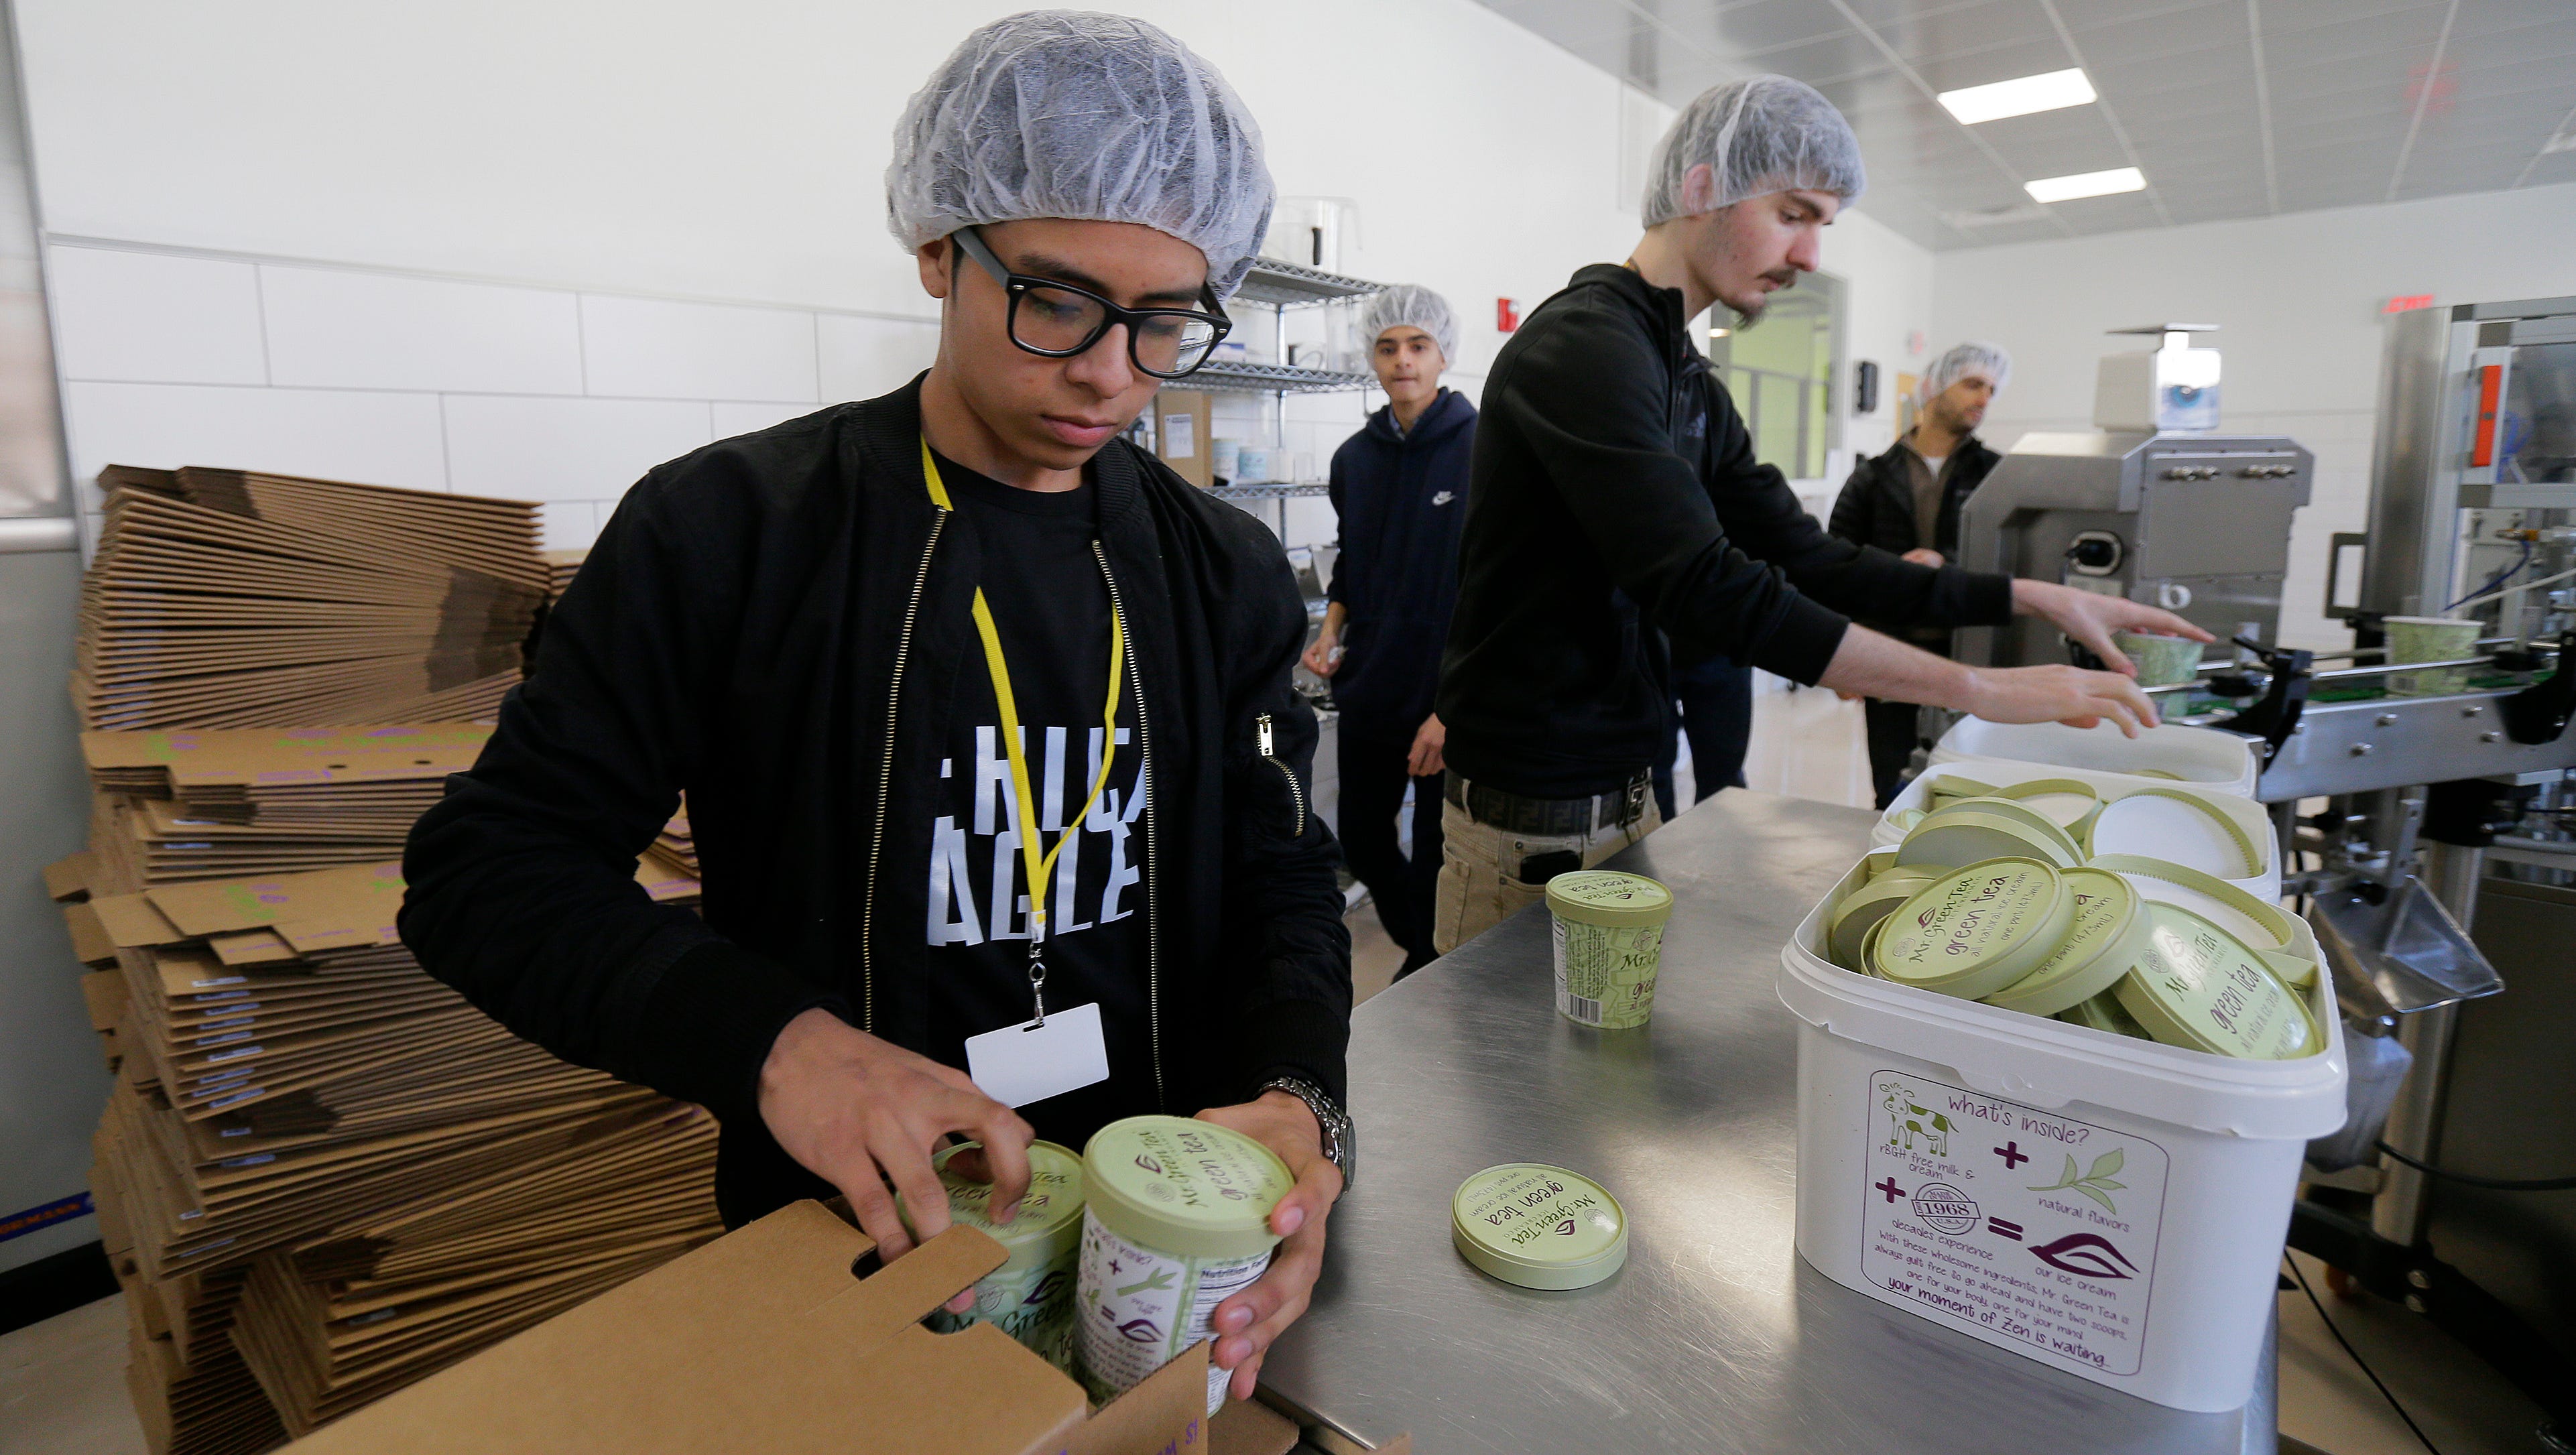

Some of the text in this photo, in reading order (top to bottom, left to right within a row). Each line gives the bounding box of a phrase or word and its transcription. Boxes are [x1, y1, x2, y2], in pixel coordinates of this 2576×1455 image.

[1909, 877, 1973, 963] Mr. Green Tea
[1945, 875, 2010, 956] green tea
[1971, 946, 1984, 958] all
[2006, 872, 2030, 897] cream
[2071, 913, 2114, 944] (473mL)
[2076, 897, 2113, 922] cream
[2195, 932, 2219, 952] Tea
[1620, 953, 1647, 970] Mr.
[2225, 963, 2262, 993] tea
[2210, 985, 2248, 1034] green
[1948, 1094, 2090, 1146] what's inside?
[1177, 1133, 1208, 1154] tea
[1880, 1143, 1906, 1160] rBGH
[1912, 1152, 1934, 1168] free
[1938, 1163, 1960, 1176] milk
[1198, 1160, 1249, 1200] green
[1508, 1177, 1537, 1196] natural
[1909, 1163, 1943, 1180] cream
[1468, 1199, 1497, 1218] cream
[1483, 1180, 1564, 1227] green tea
[1511, 1193, 1597, 1247] Mr. Green Tea
[1923, 1202, 1970, 1216] 1968
[2038, 1197, 2130, 1233] natural flavors
[1892, 1218, 1994, 1261] decades experience
[1875, 1243, 1904, 1260] always
[1965, 1277, 1976, 1287] go
[1979, 1281, 2011, 1300] ahead
[2014, 1295, 2034, 1308] and
[2038, 1300, 2064, 1318] have
[2068, 1312, 2087, 1326] two
[1903, 1238, 1927, 1254] these
[1930, 1249, 1980, 1273] wholesome
[2062, 1294, 2094, 1313] Green
[2098, 1306, 2118, 1321] Tea
[2035, 1266, 2117, 1301] our ice cream
[1888, 1277, 1913, 1293] your
[1918, 1287, 1975, 1318] moment
[1980, 1312, 1997, 1324] of
[2002, 1316, 2030, 1338] Zen
[2035, 1330, 2046, 1344] is
[1907, 1270, 1923, 1281] one
[1926, 1275, 1941, 1287] for
[1943, 1284, 1961, 1295] your
[1993, 1302, 2010, 1314] one
[2014, 1308, 2030, 1320] for
[2032, 1316, 2052, 1328] your
